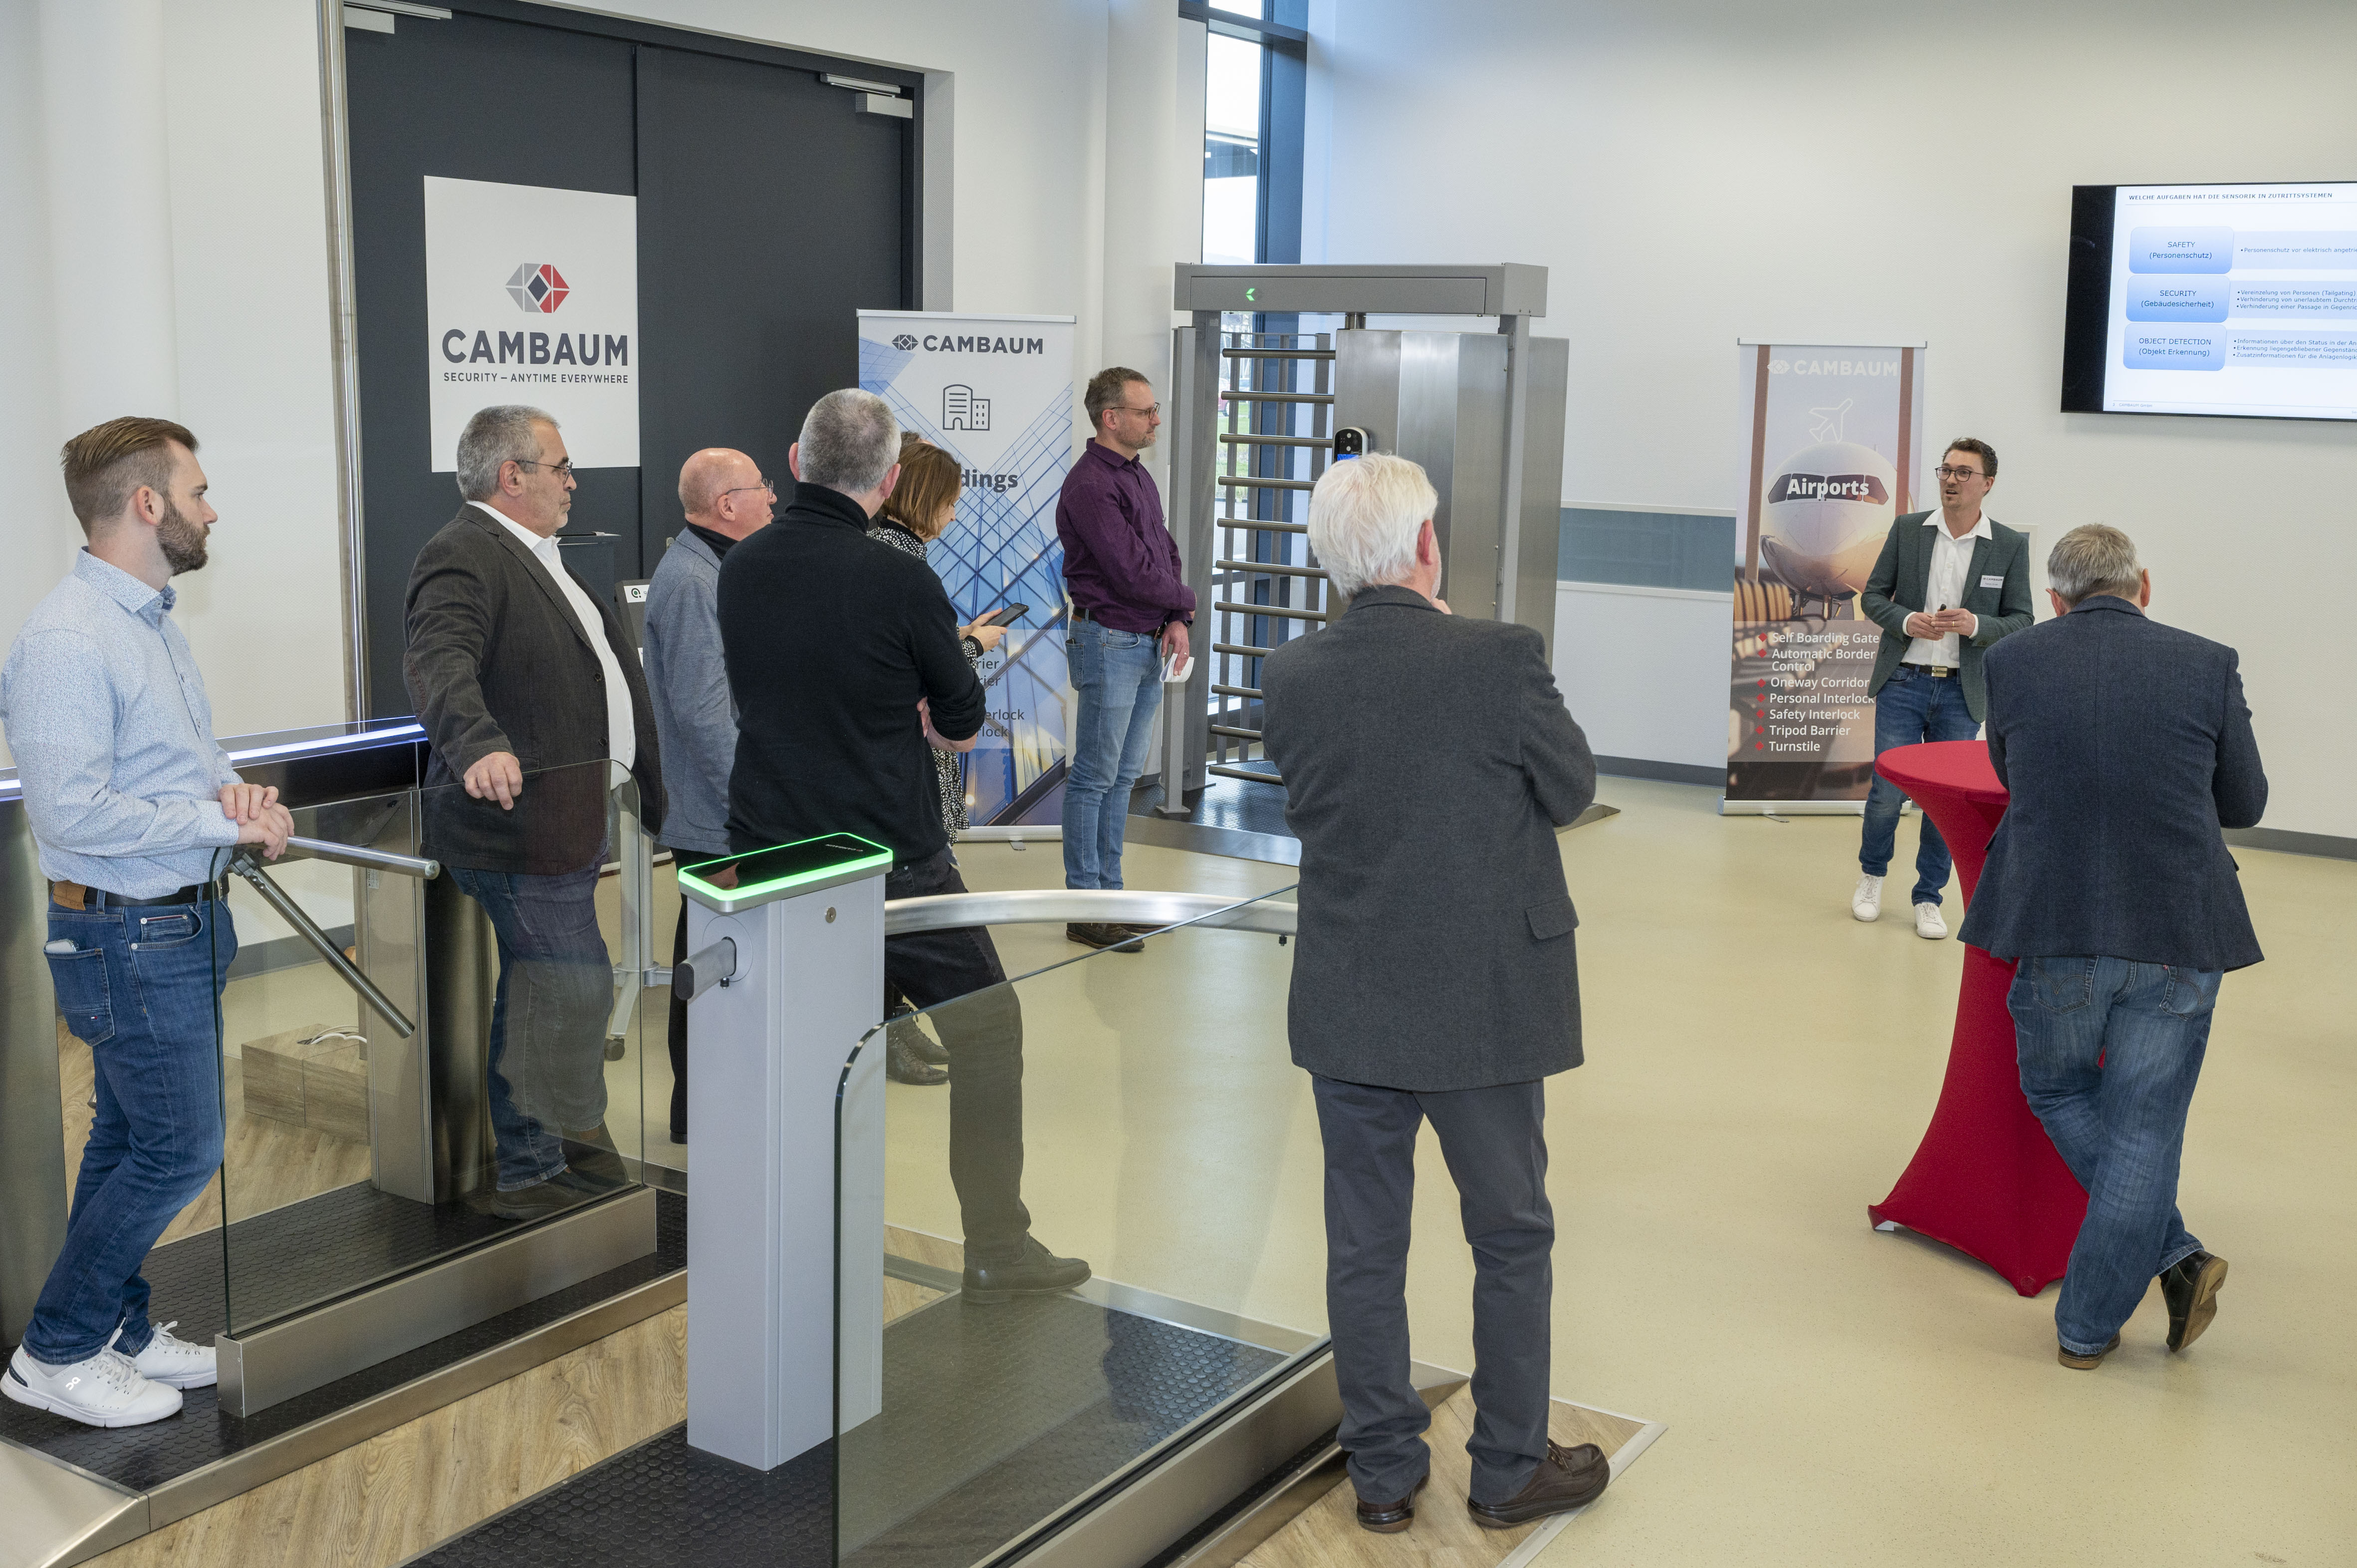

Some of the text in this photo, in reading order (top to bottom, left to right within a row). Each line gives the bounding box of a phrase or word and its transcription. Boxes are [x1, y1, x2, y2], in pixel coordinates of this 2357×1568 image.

[442, 329, 628, 366] CAMBAUM
[923, 335, 1043, 354] CAMBAUM
[1794, 360, 1897, 376] CAMBAUM
[444, 372, 498, 382] SECURITY
[510, 373, 557, 383] ANYTIME
[561, 374, 628, 383] EVERYWHERE
[961, 469, 1018, 493] dings
[1787, 478, 1869, 499] Airports
[1772, 633, 1880, 646] Self Boarding Gate
[1772, 649, 1876, 659] Automatic Border
[1772, 661, 1815, 672] Control
[1771, 677, 1870, 690] Oneway Corridor
[1770, 693, 1820, 703] Personal
[985, 709, 1025, 720] erlock
[1769, 709, 1860, 722] Safety Interlock
[1769, 725, 1851, 738] Tripod Barrier
[1769, 741, 1820, 751] Turnstile
